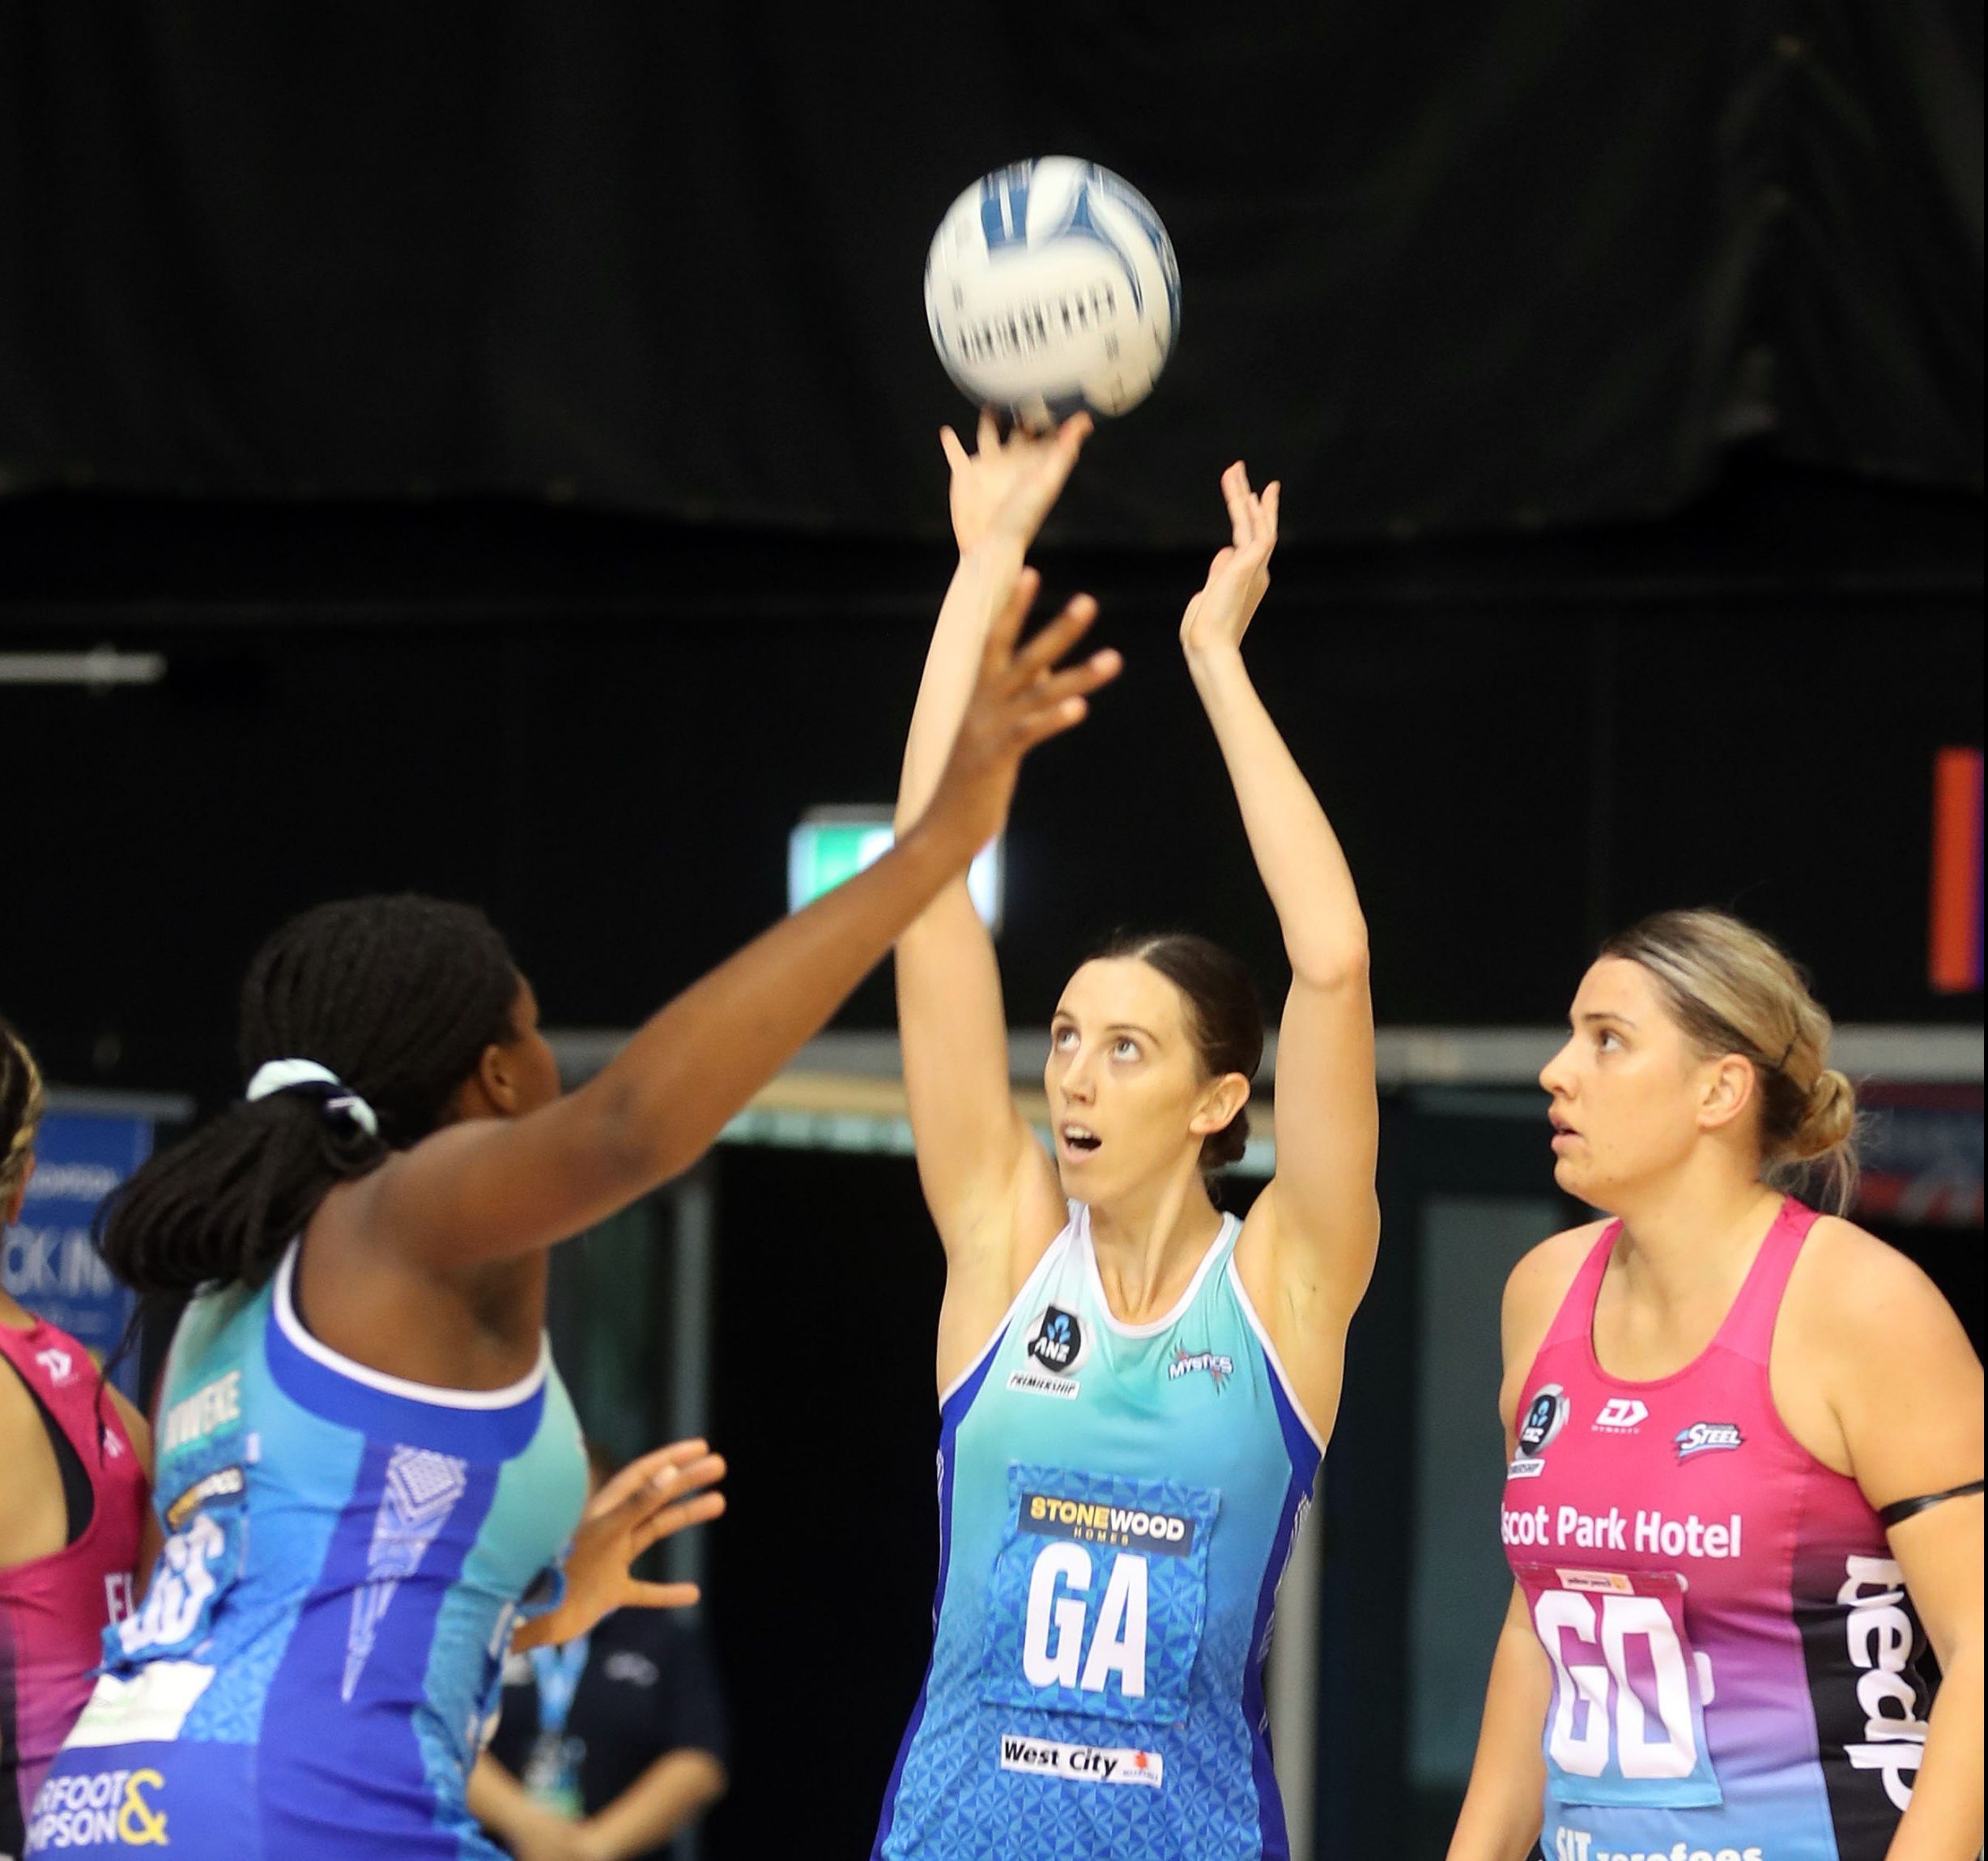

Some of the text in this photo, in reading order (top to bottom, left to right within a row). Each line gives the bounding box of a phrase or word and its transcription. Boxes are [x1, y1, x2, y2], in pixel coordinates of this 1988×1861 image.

[1034, 1336, 1071, 1362] ANZ
[1168, 1353, 1232, 1380] MYSTICS
[1680, 1422, 1742, 1450] STEEL
[1030, 1496, 1185, 1541] STONEWOOD
[1501, 1502, 1741, 1558] scot Park Hotel
[1021, 1540, 1148, 1698] GA
[1535, 1590, 1697, 1778] GD
[1005, 1741, 1059, 1767] West
[1069, 1748, 1118, 1781] City
